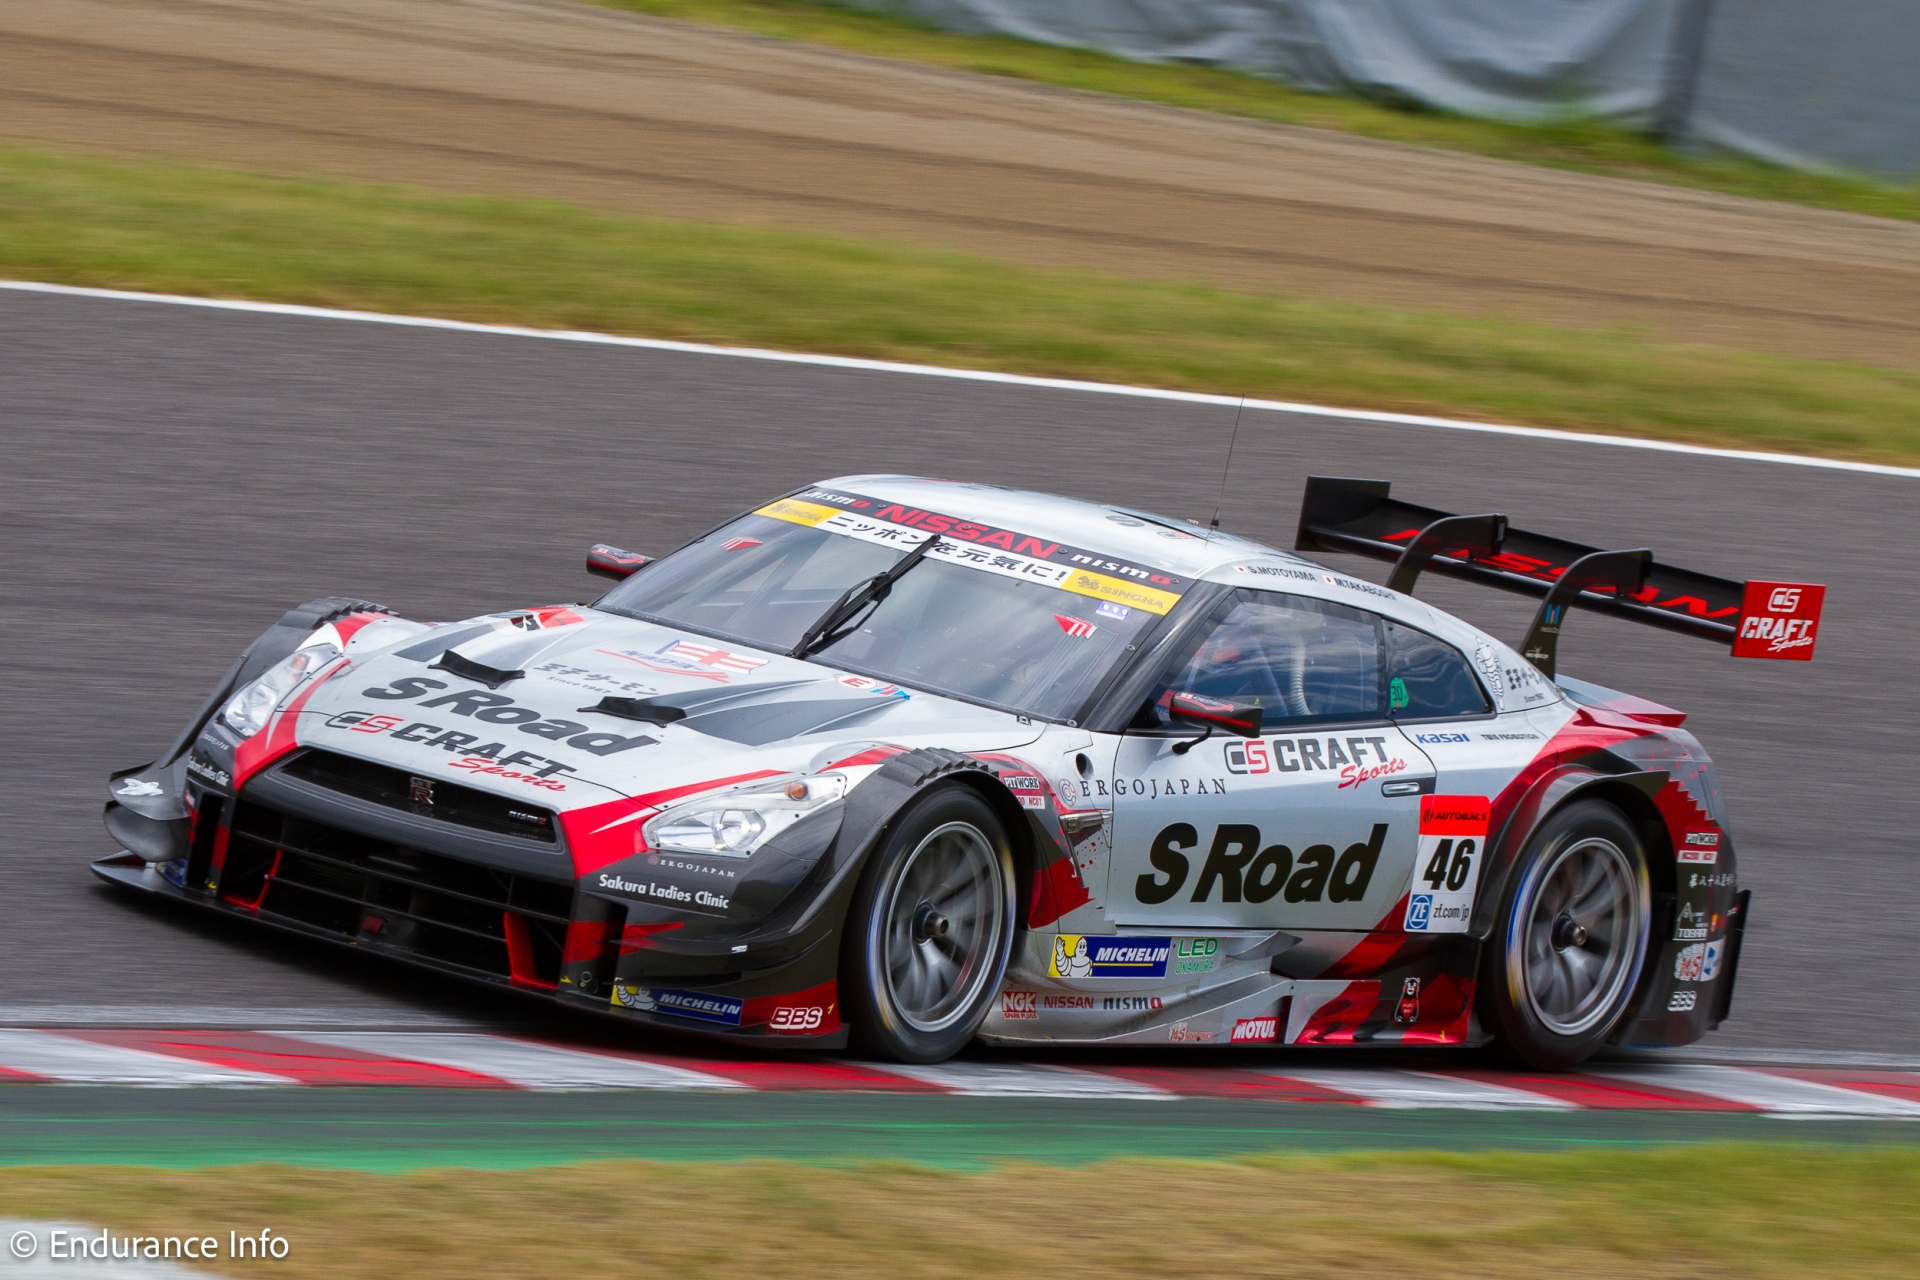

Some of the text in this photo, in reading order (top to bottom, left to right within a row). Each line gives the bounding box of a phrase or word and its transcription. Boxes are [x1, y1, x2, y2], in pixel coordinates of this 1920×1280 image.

[805, 491, 869, 510] nismo
[874, 504, 1173, 586] NISSAN nismo
[1249, 566, 1317, 582] S.MOTOYAMA
[1100, 586, 1164, 609] SINGHA
[1740, 616, 1814, 640] CRAFT
[362, 677, 660, 757] S Road
[390, 723, 577, 779] CRAFT
[1273, 737, 1388, 772] CRAFT
[410, 776, 436, 788] GT
[448, 758, 566, 792] Sports
[1004, 776, 1040, 790] PITWORK
[1337, 758, 1408, 790] Sports
[410, 787, 435, 804] R
[1079, 778, 1227, 799] ERGOJAPAN
[1434, 811, 1487, 821] AUTOBACS
[660, 859, 736, 878] ERGOJAPAN
[1134, 822, 1389, 905] S Road
[1423, 838, 1475, 892] 46
[598, 873, 730, 909] Sakura Ladies Clinic
[1095, 947, 1170, 962] MICHELIN
[1178, 938, 1219, 958] LED
[1174, 961, 1214, 974] OKAMURA
[660, 993, 742, 1016] MICHELIN
[1002, 991, 1036, 1013] NGK
[1044, 995, 1164, 1010] NISSAN nismo
[770, 1007, 822, 1030] BBS
[1233, 1020, 1277, 1040] MOTUL
